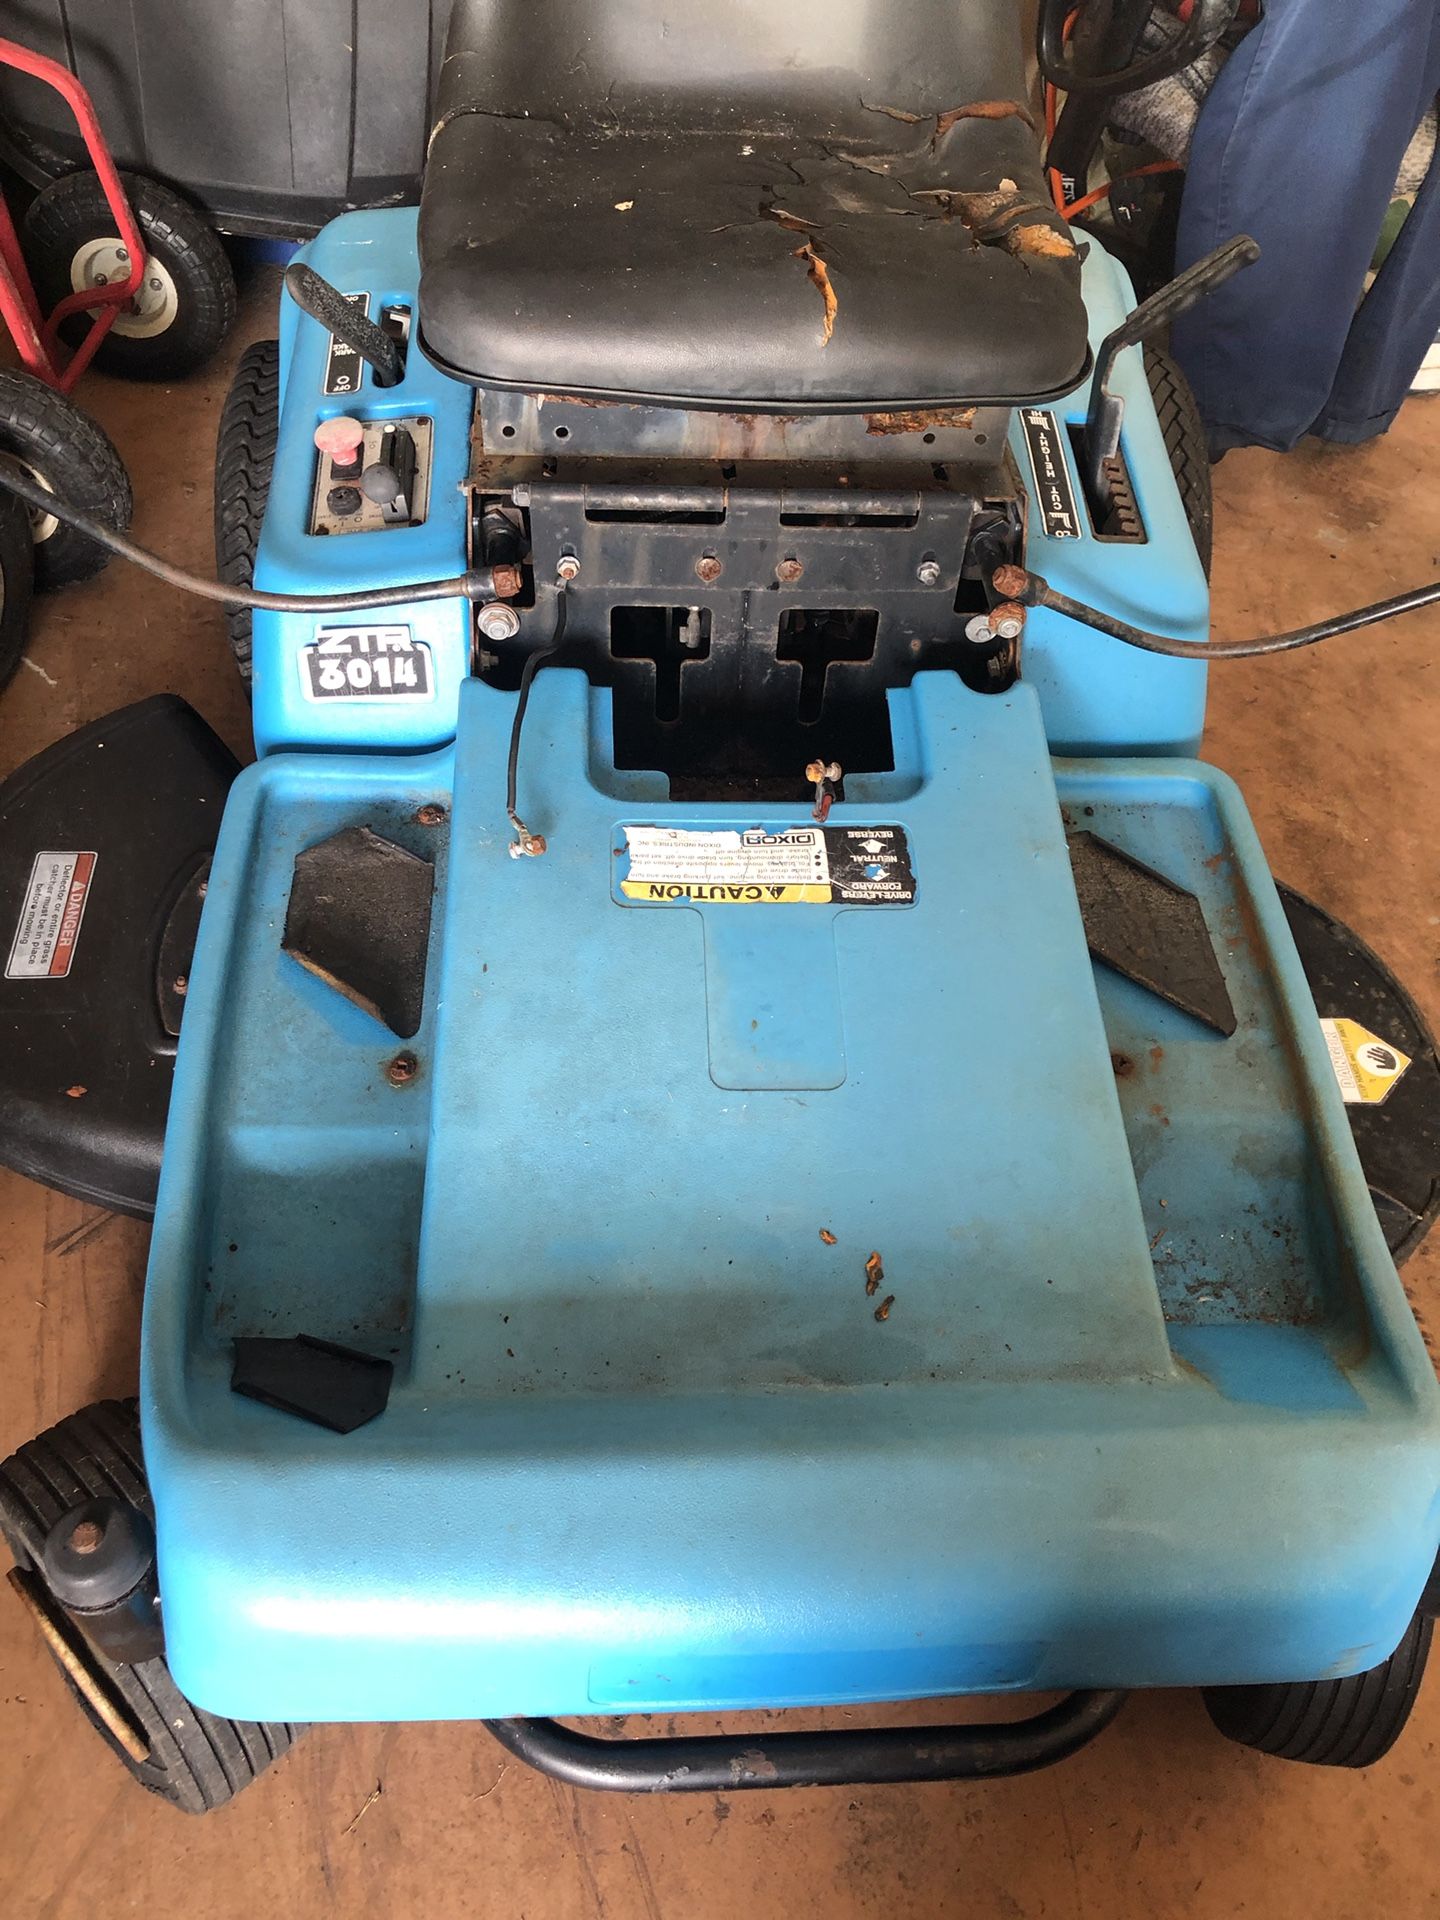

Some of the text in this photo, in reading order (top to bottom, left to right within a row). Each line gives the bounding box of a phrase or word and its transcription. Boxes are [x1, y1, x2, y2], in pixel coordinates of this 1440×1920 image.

[333, 384, 351, 392] OFF
[1038, 432, 1062, 511] CUT HEIGHT
[745, 835, 811, 845] DIXON
[46, 864, 60, 892] catcher
[57, 864, 73, 901] Deflector
[851, 882, 902, 890] FORWARD
[648, 885, 763, 899] CAUTION
[884, 891, 912, 899] DRIVE
[20, 883, 45, 945] before mowing
[40, 896, 52, 917] must
[46, 914, 59, 938] entire
[59, 893, 81, 947] DANGER
[28, 942, 41, 965] place
[40, 940, 53, 965] grass
